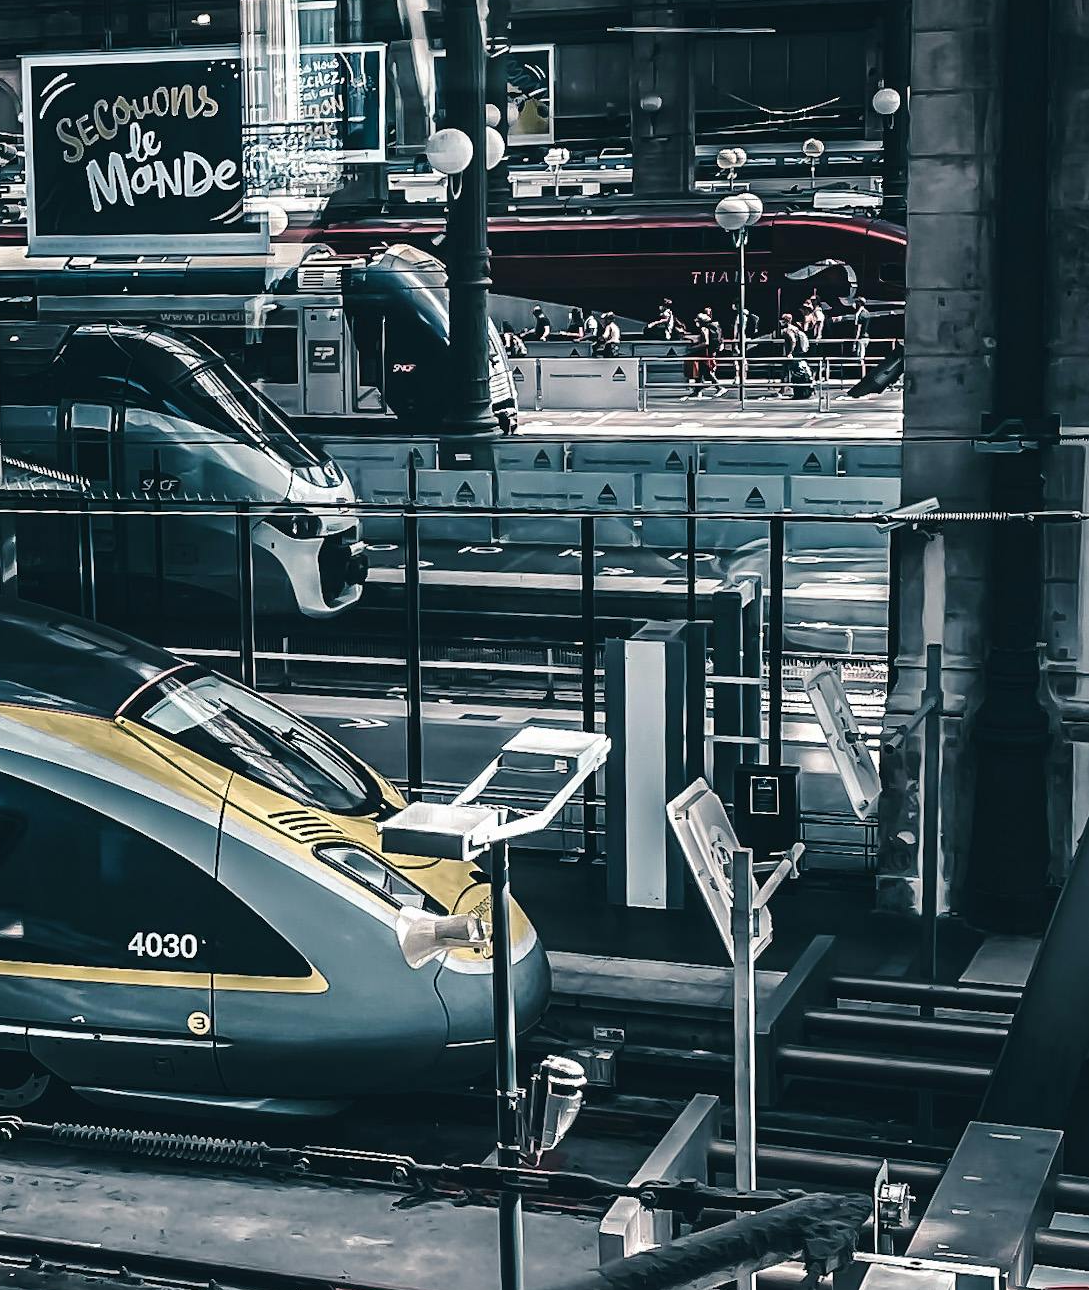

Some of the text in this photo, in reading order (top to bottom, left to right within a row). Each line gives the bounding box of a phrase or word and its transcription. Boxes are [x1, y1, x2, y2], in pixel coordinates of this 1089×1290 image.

[125, 122, 162, 162] le
[691, 270, 769, 284] THALYS
[393, 363, 416, 373] SNCF
[128, 932, 198, 958] 4030
[193, 1017, 206, 1030] 3
